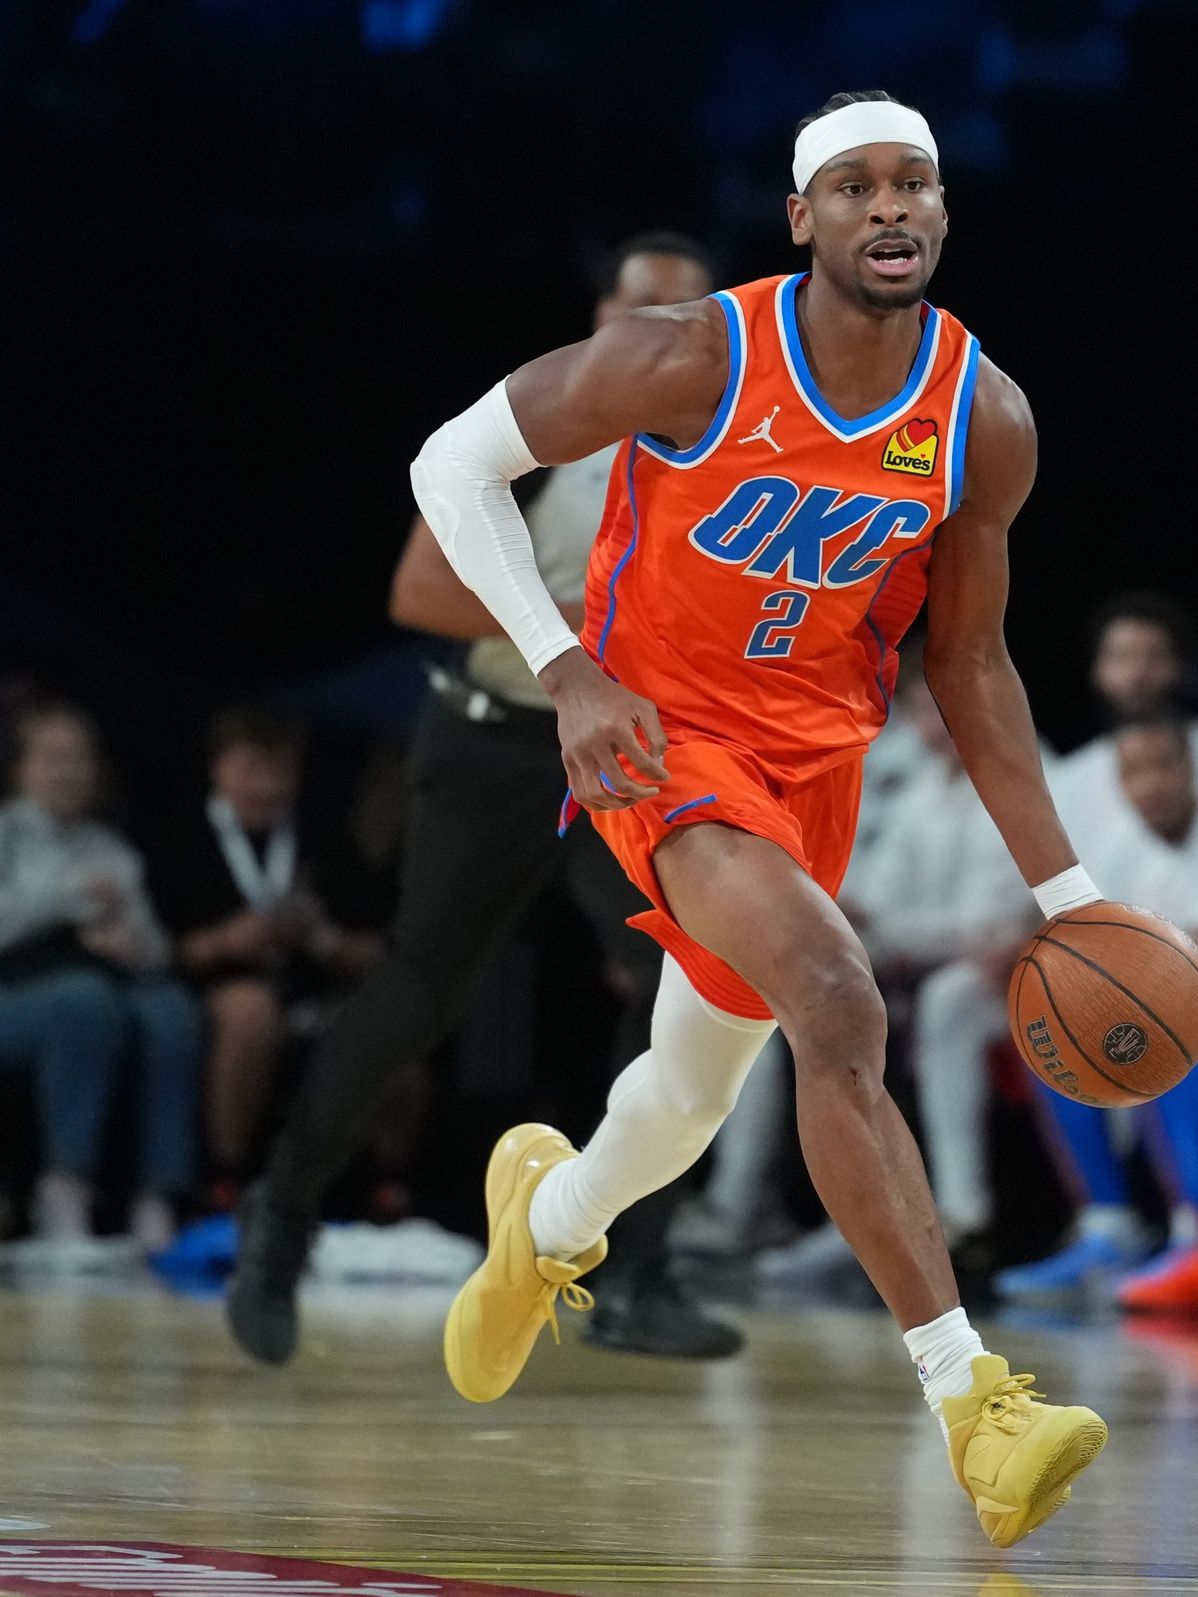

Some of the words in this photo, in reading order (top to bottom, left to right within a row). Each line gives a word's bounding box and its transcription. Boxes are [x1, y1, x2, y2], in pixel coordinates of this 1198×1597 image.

[688, 475, 931, 590] OKC
[744, 589, 811, 659] 2
[1026, 1015, 1102, 1104] Wils
